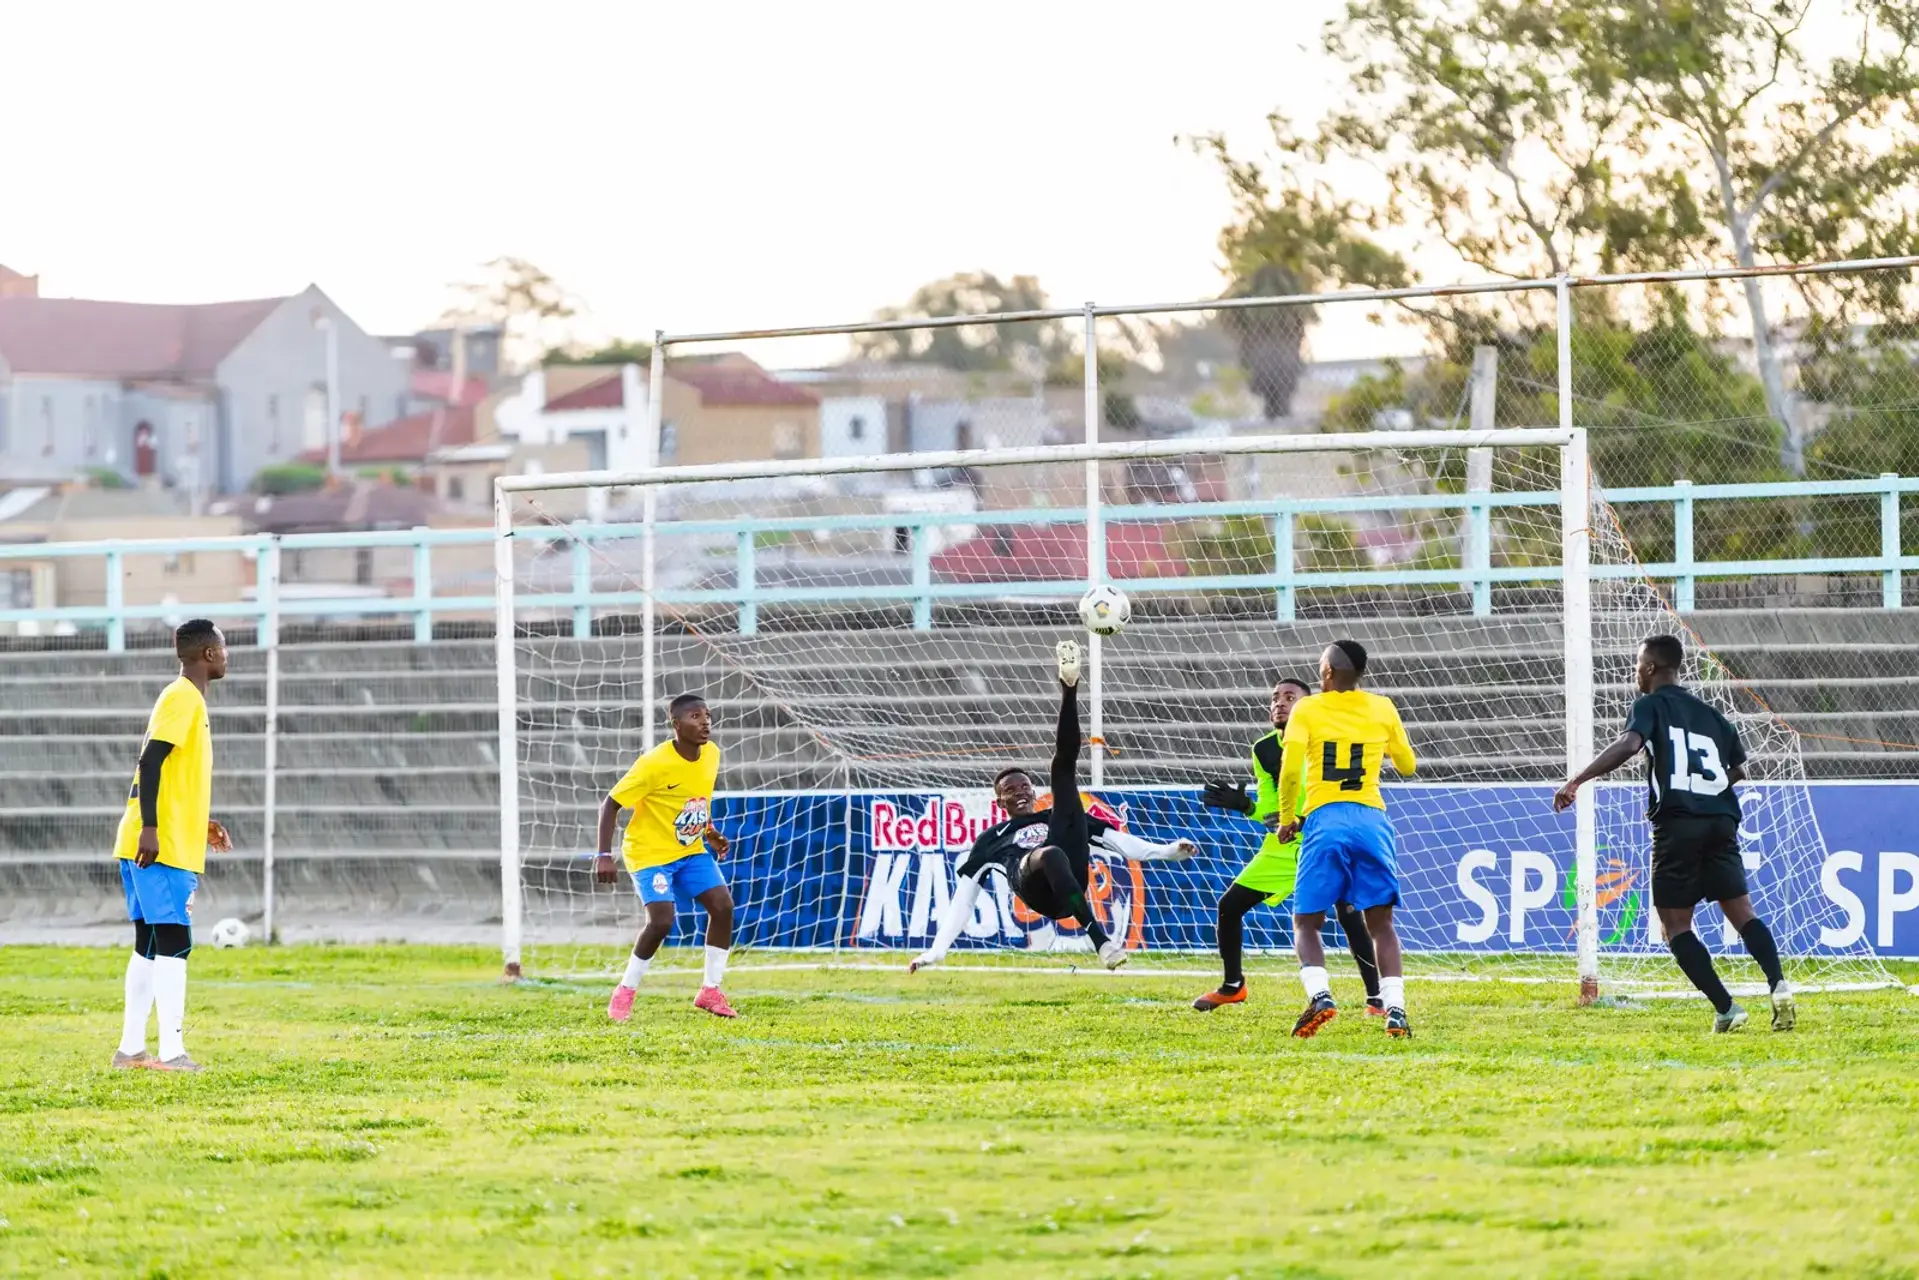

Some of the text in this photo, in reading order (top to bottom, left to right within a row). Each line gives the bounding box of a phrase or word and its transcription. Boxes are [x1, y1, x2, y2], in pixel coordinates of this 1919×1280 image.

[1322, 740, 1367, 792] 4
[1668, 725, 1729, 796] 13
[873, 800, 938, 847] Red
